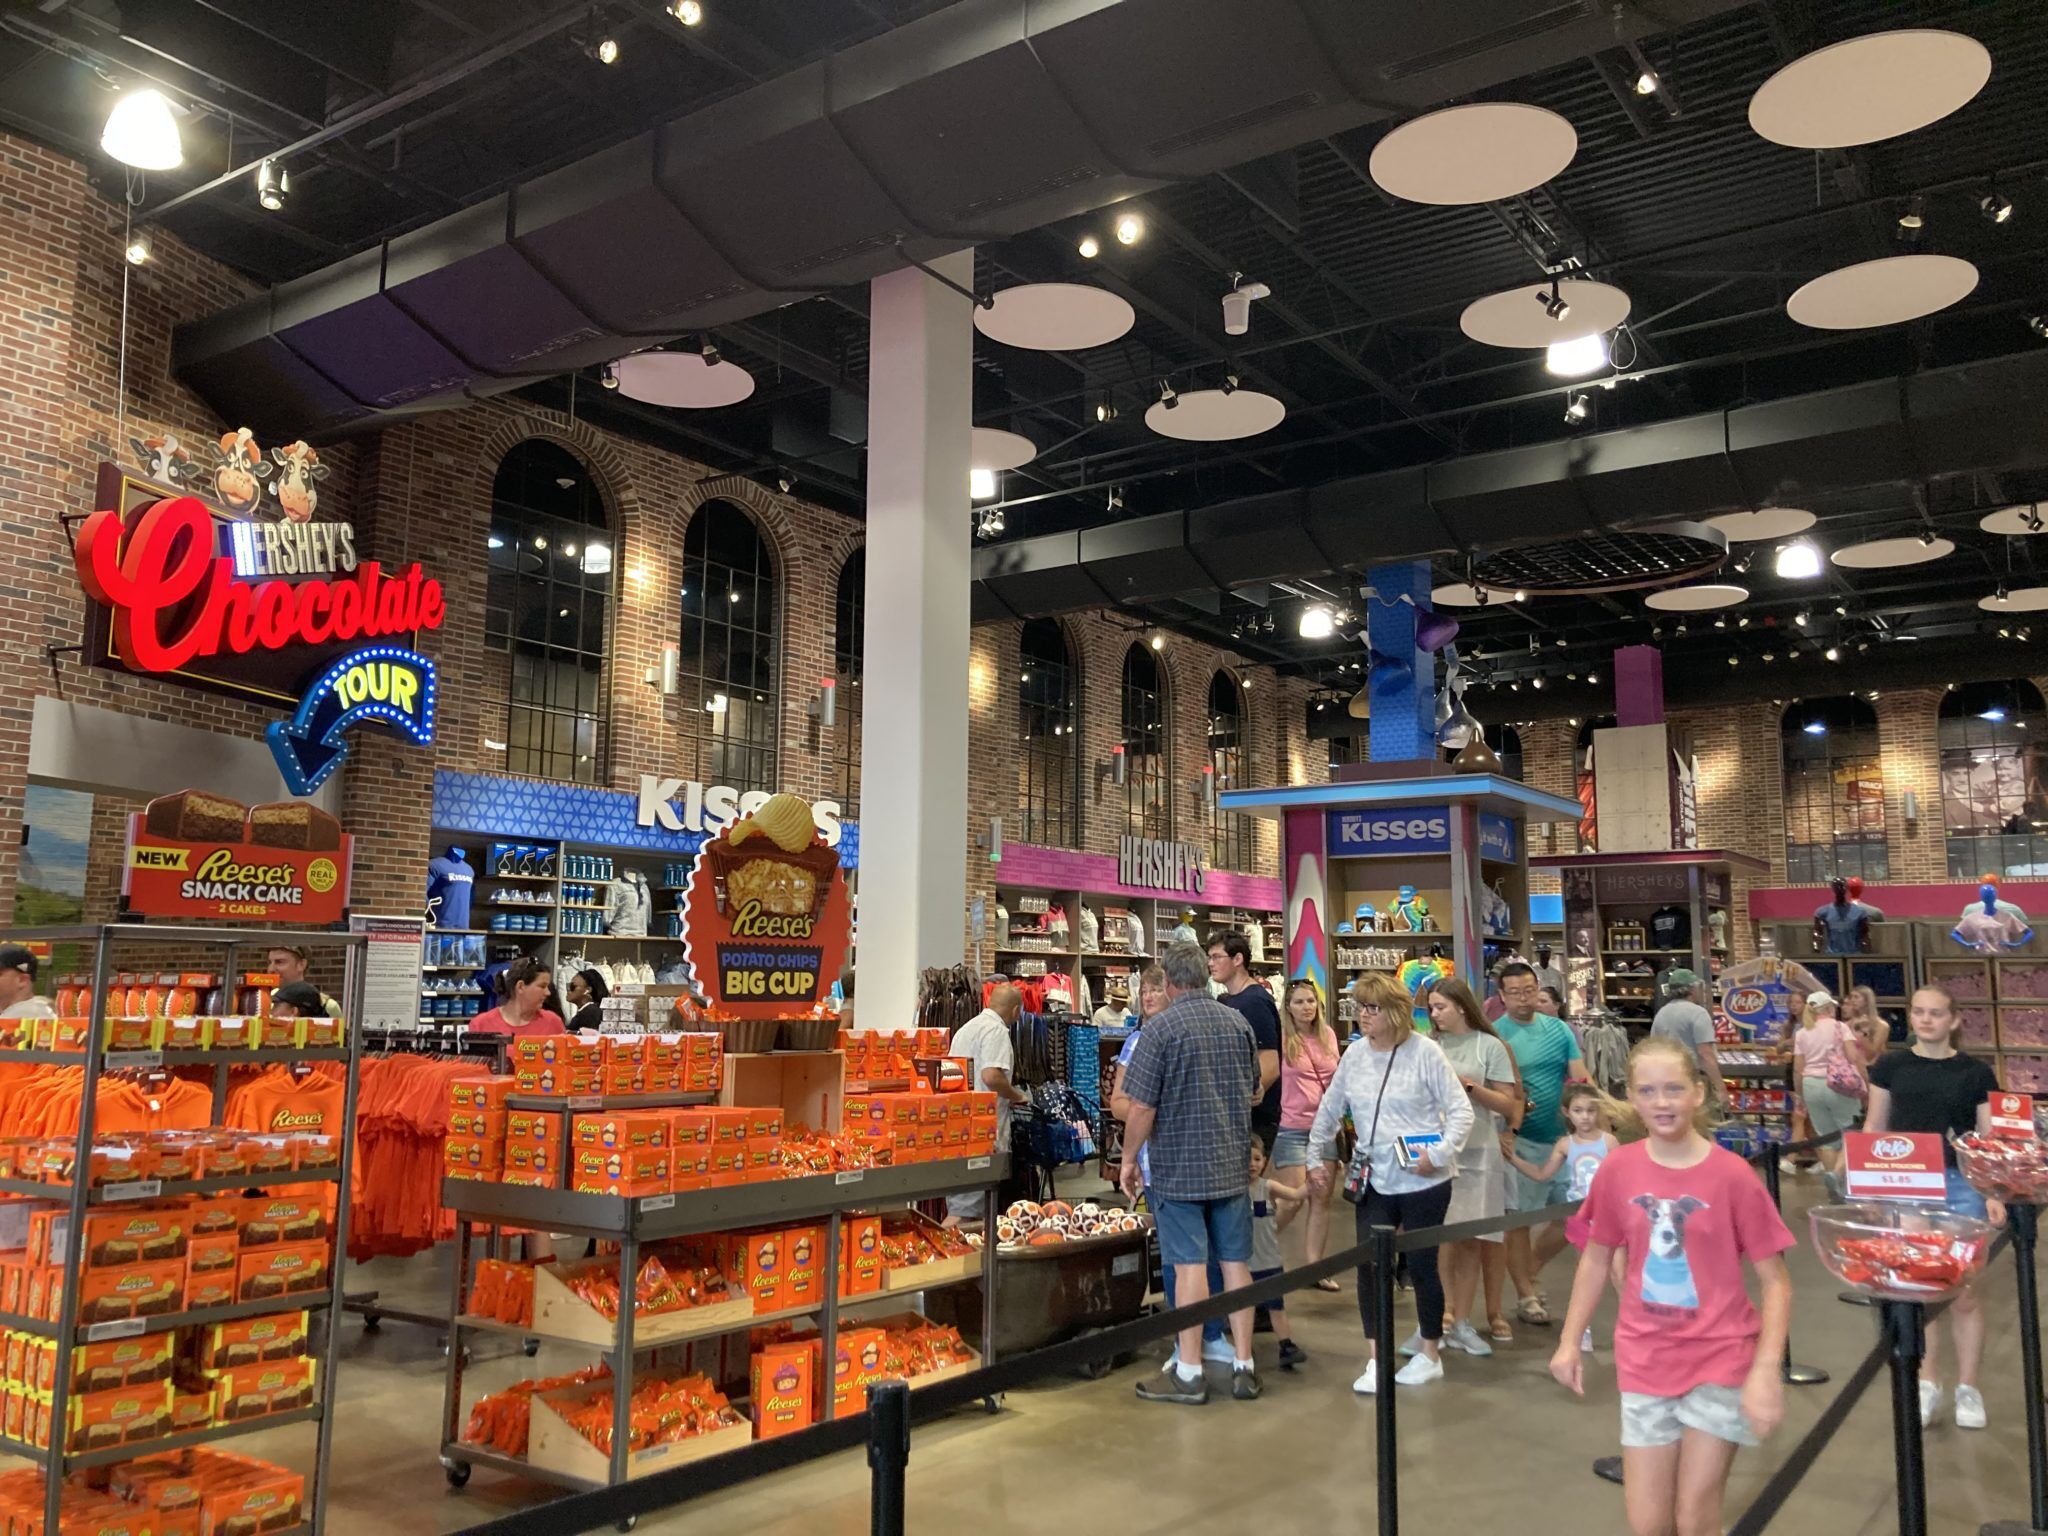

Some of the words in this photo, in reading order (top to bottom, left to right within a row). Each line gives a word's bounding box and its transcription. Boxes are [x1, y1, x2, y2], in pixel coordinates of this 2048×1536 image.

[231, 521, 357, 576] HERSHEY'S
[76, 497, 445, 672] Chocolate
[333, 663, 418, 714] TOUR
[135, 851, 182, 867] NEW
[196, 849, 296, 886] Reese's
[1119, 834, 1205, 894] HERSHEY'S
[310, 870, 334, 879] REAL
[181, 881, 251, 901] SNACK
[254, 885, 303, 904] CAKE
[219, 904, 227, 913] 2
[228, 904, 267, 915] CAKES
[731, 899, 815, 939] Reese's
[721, 951, 776, 968] POTATO
[777, 953, 819, 969] CHIPS
[726, 970, 767, 995] BIG
[769, 971, 815, 995] CUP
[271, 1109, 323, 1128] Reese's
[766, 1396, 802, 1411] Reese's
